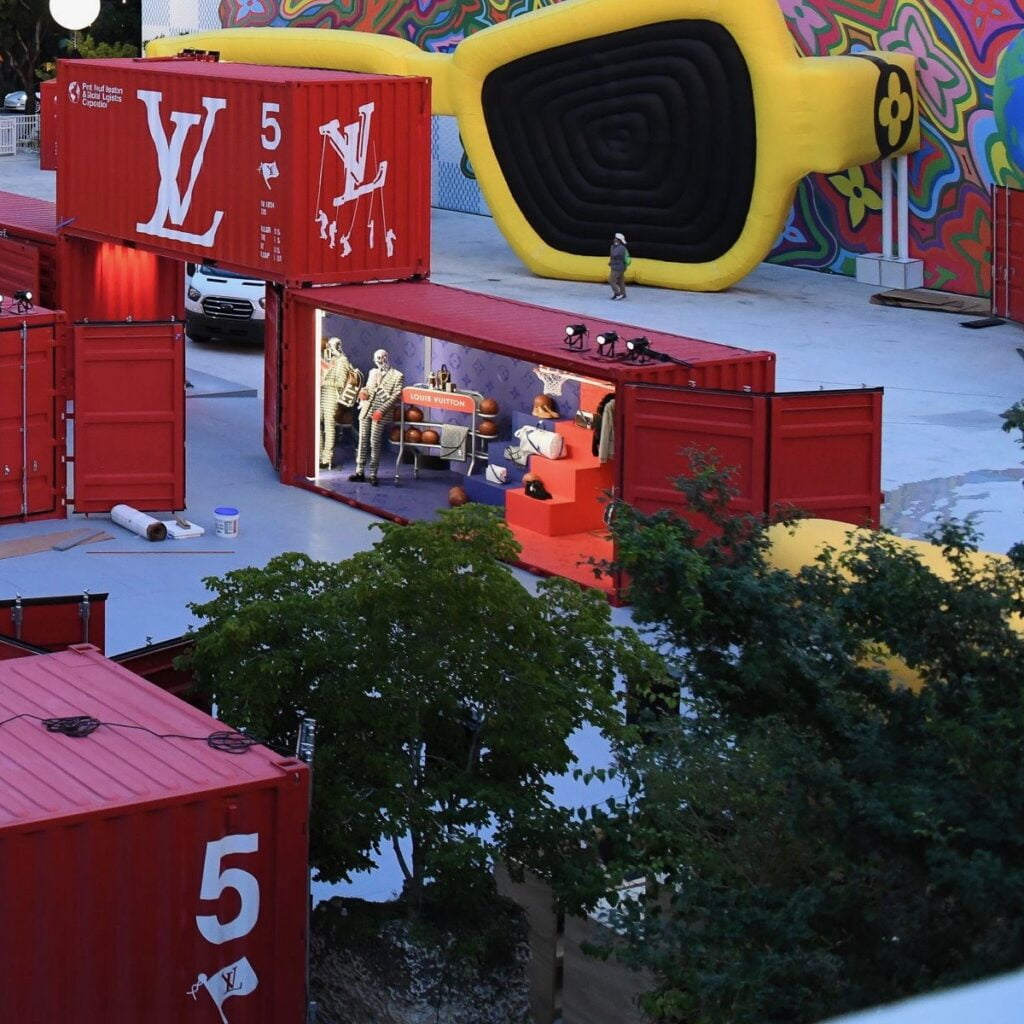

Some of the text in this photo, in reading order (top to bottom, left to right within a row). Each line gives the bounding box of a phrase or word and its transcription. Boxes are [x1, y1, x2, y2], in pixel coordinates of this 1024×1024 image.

[136, 89, 282, 248] LV 5
[319, 101, 388, 207] LV
[410, 393, 465, 407] LOUIS VUITTON
[195, 832, 261, 945] 5
